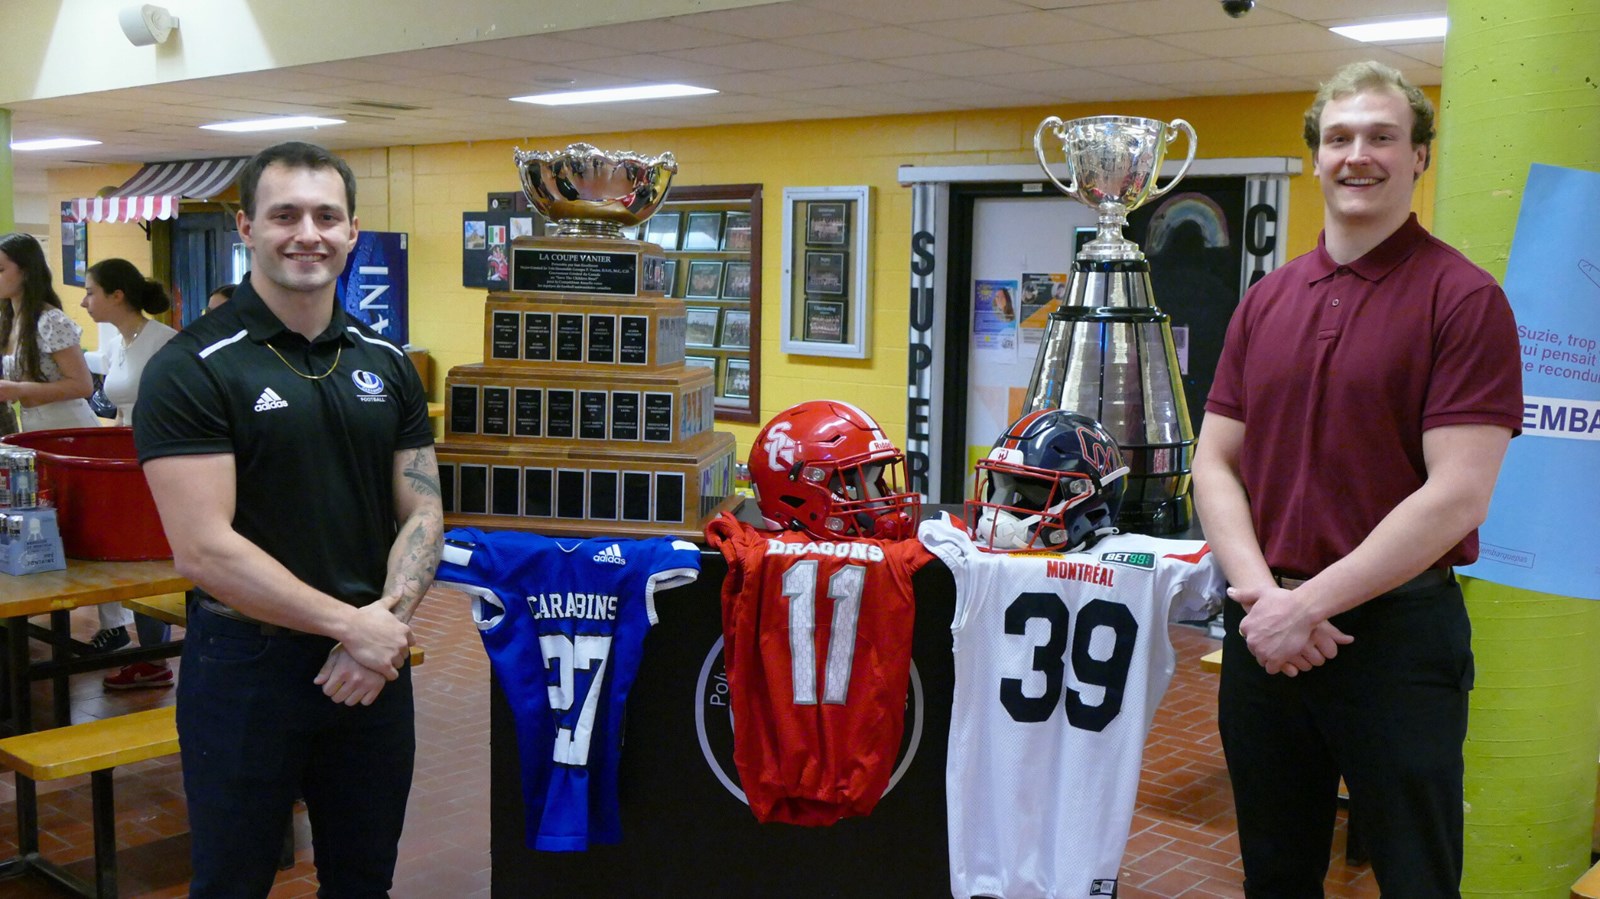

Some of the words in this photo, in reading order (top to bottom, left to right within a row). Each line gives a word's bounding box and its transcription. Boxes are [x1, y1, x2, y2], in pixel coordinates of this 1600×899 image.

[1518, 325, 1562, 346] Suzie,
[1568, 334, 1596, 352] trop
[907, 231, 935, 494] SUPER
[1520, 344, 1538, 356] ui
[1542, 348, 1597, 366] pensait
[1521, 361, 1534, 372] e
[254, 399, 288, 412] adidas
[593, 554, 625, 565] adidas
[766, 539, 884, 562] DRAGONS
[1106, 552, 1147, 565] BET99
[1046, 560, 1114, 587] MONTRÉAL
[526, 592, 618, 621] CARABINS
[782, 560, 866, 706] 11
[1000, 592, 1139, 732] 39
[538, 634, 613, 765] 27
